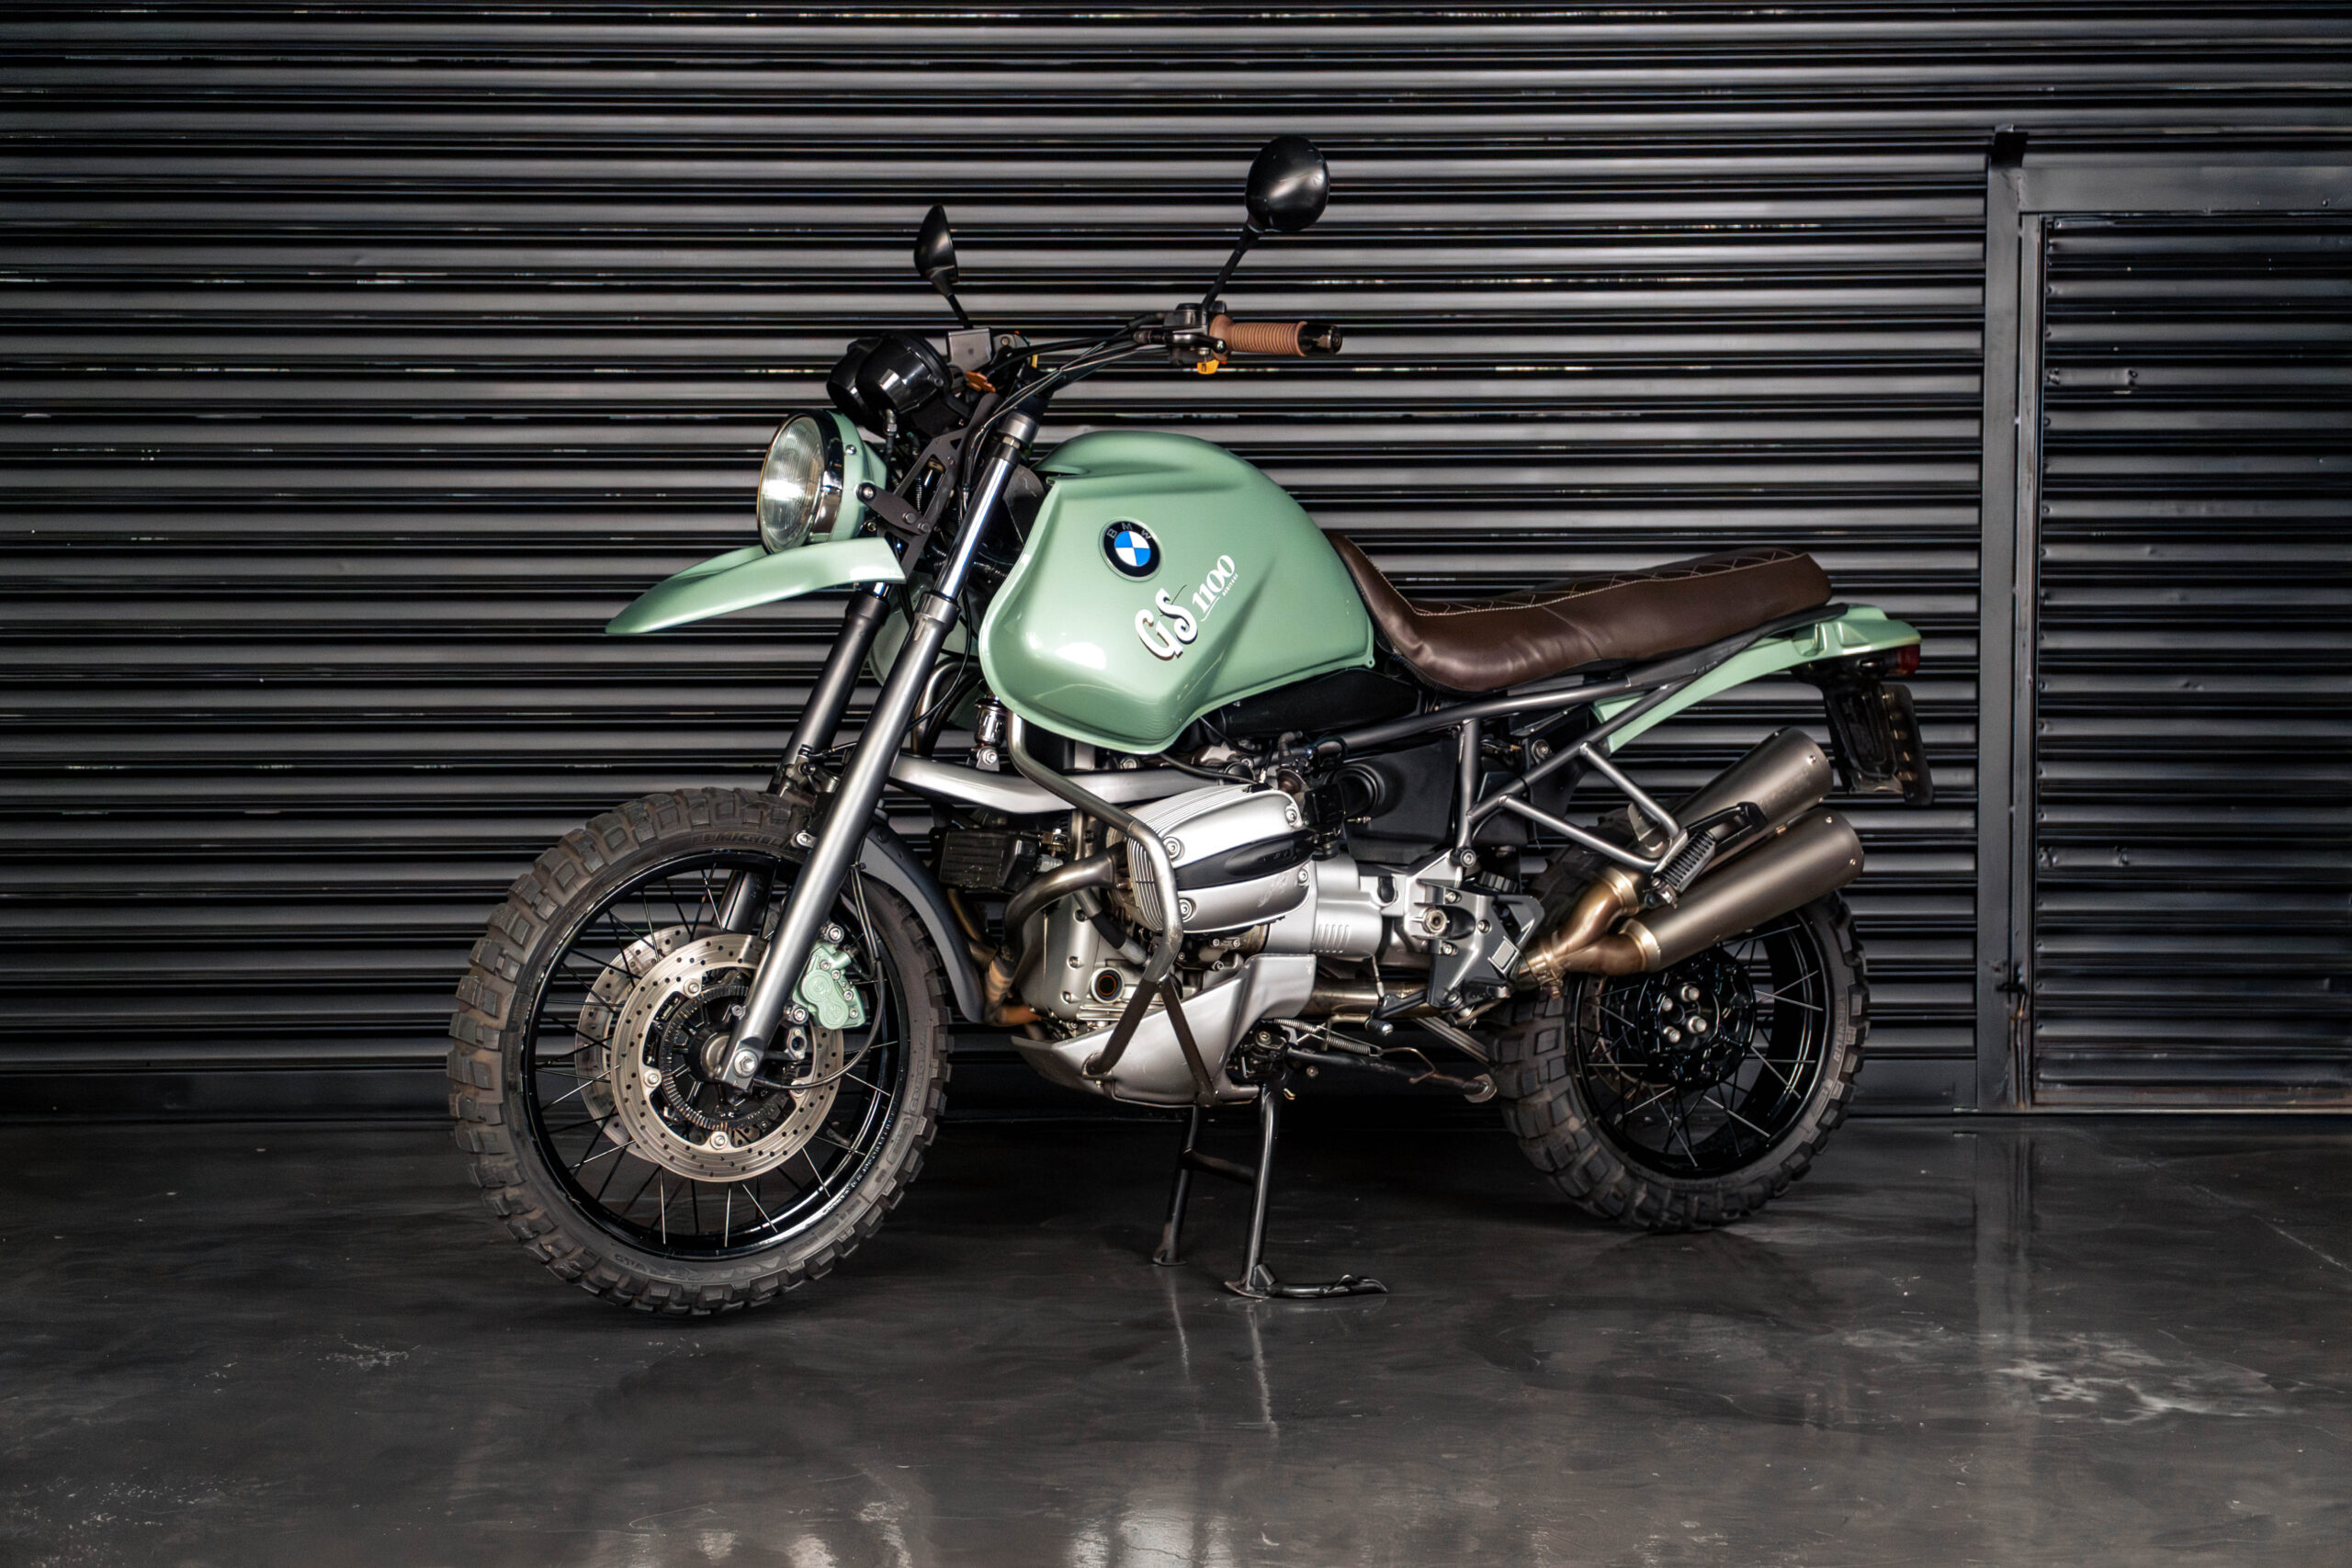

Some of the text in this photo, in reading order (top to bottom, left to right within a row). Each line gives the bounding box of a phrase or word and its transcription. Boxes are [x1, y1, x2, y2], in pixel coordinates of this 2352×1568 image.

[1106, 522, 1152, 540] BMW
[1135, 554, 1236, 661] GS 1100
